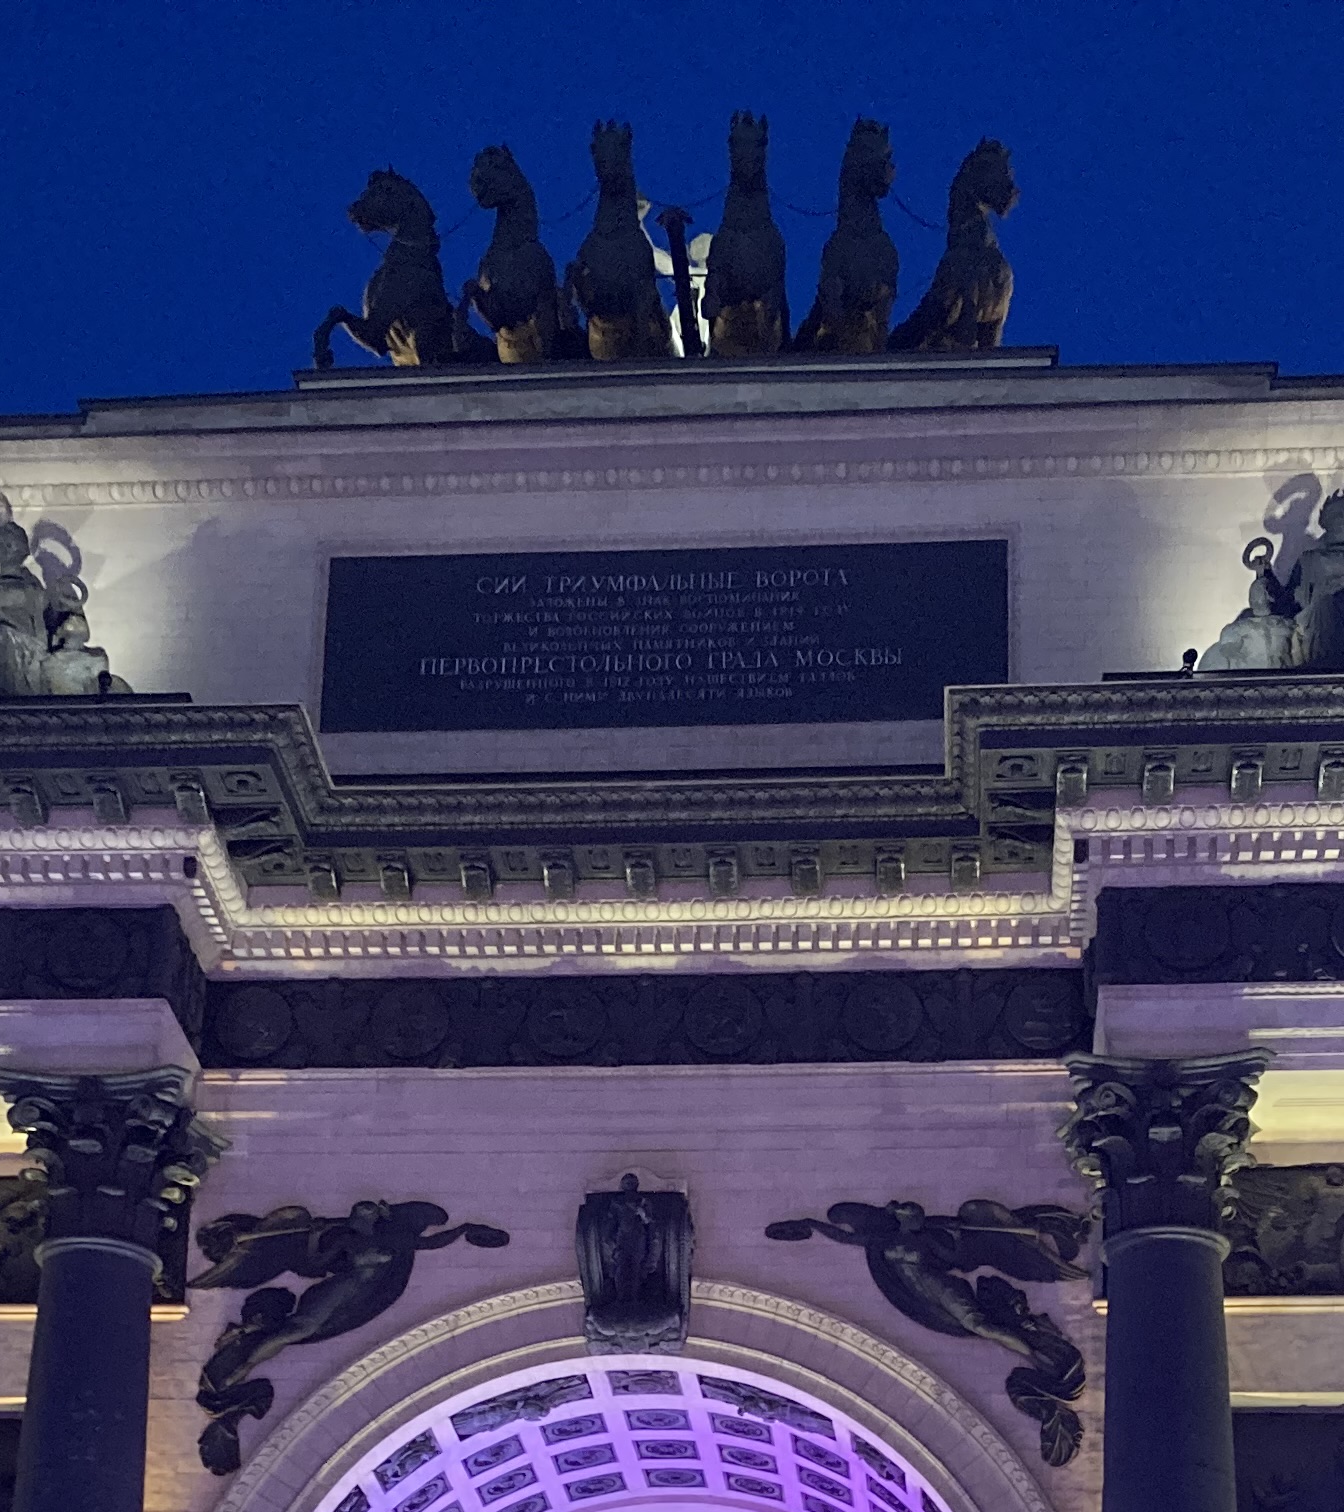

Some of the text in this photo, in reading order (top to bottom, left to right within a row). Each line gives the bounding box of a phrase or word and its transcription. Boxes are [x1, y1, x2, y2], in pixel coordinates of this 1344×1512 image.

[476, 568, 850, 594] СИИ ТРИУМФАЛЬНЫЕ ВОРОТА
[419, 647, 904, 676] ПЕРВОПРЕСТОЛЬНОГО ГРАДА МОСКВЫ
